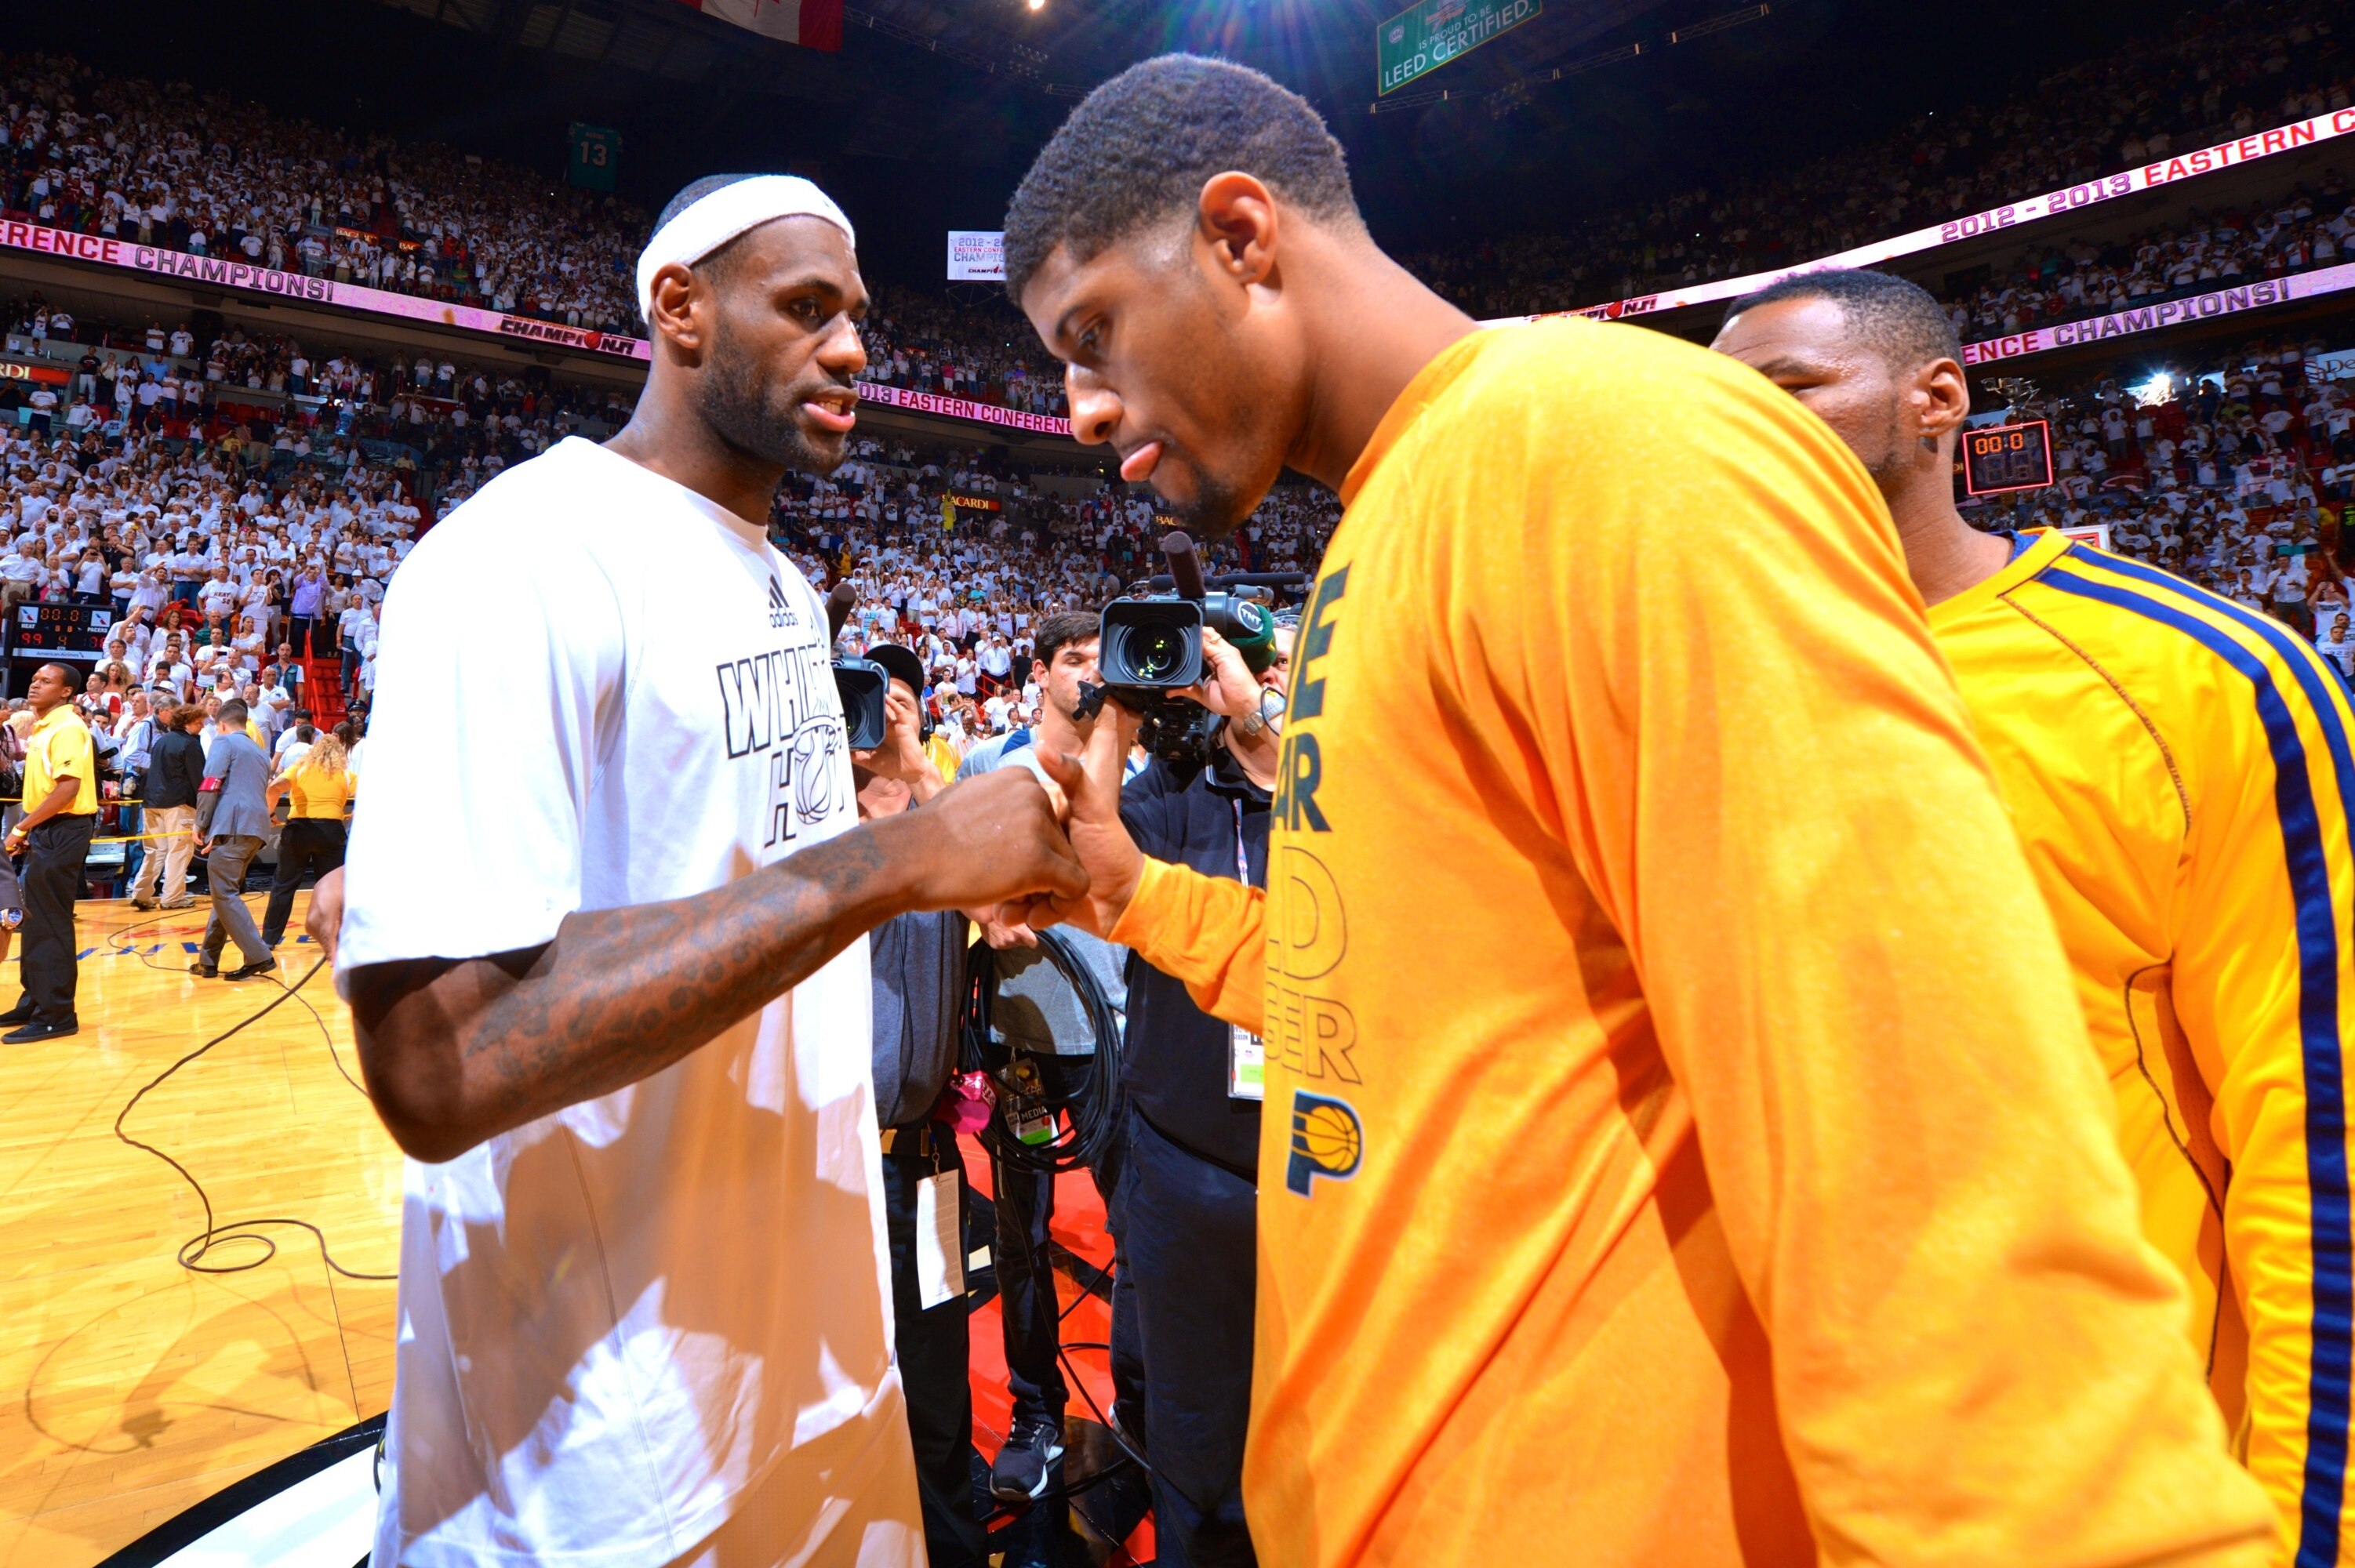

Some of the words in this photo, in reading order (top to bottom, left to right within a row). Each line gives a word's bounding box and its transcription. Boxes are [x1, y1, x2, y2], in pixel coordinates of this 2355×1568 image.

[1419, 42, 1427, 50] IS
[1430, 22, 1462, 45] PROUD
[1464, 13, 1477, 25] TO
[1480, 5, 1492, 17] BE
[1385, 53, 1426, 88] LEED
[1433, 1, 1533, 61] CERTIFIED.
[580, 141, 608, 167] 13
[1941, 206, 2015, 242] 2012
[2048, 172, 2131, 213] 2013
[2143, 120, 2316, 188] EASTERN
[958, 238, 983, 246] 2012
[0, 220, 120, 263] RENCE
[135, 245, 334, 302] CHAMPIONS!
[2054, 278, 2289, 346] CHAMPIONS!
[853, 381, 892, 404] 013
[898, 389, 976, 419] EASTERN
[769, 608, 798, 628] adidas
[1241, 608, 1262, 625] TNT
[21, 633, 42, 645] 99
[1021, 1105, 1048, 1121] MEDIA
